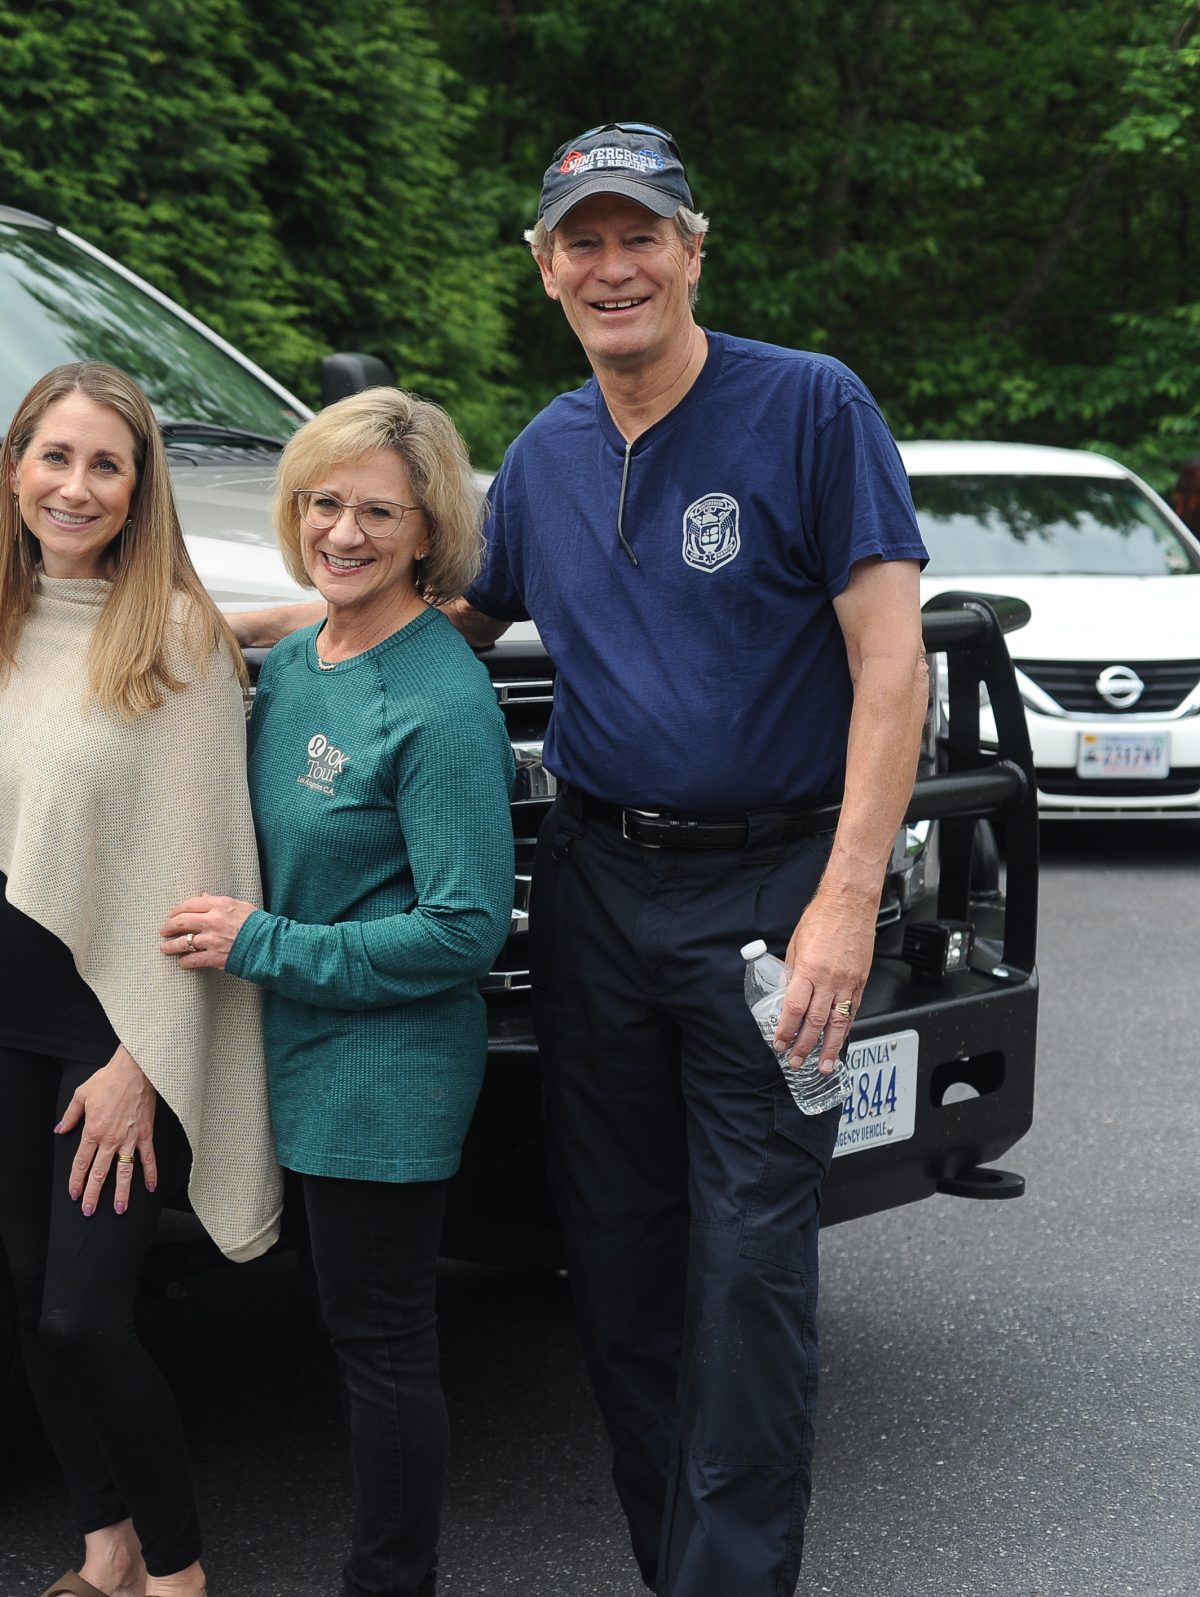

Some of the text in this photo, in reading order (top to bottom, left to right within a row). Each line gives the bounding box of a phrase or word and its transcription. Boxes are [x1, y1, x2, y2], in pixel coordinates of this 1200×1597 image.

[569, 148, 657, 171] WINTERGREEN
[573, 161, 594, 175] FIRE
[608, 159, 647, 173] RESCUE
[324, 746, 351, 773] 10K
[307, 760, 336, 782] Tour
[861, 1121, 886, 1141] VEHICLE
